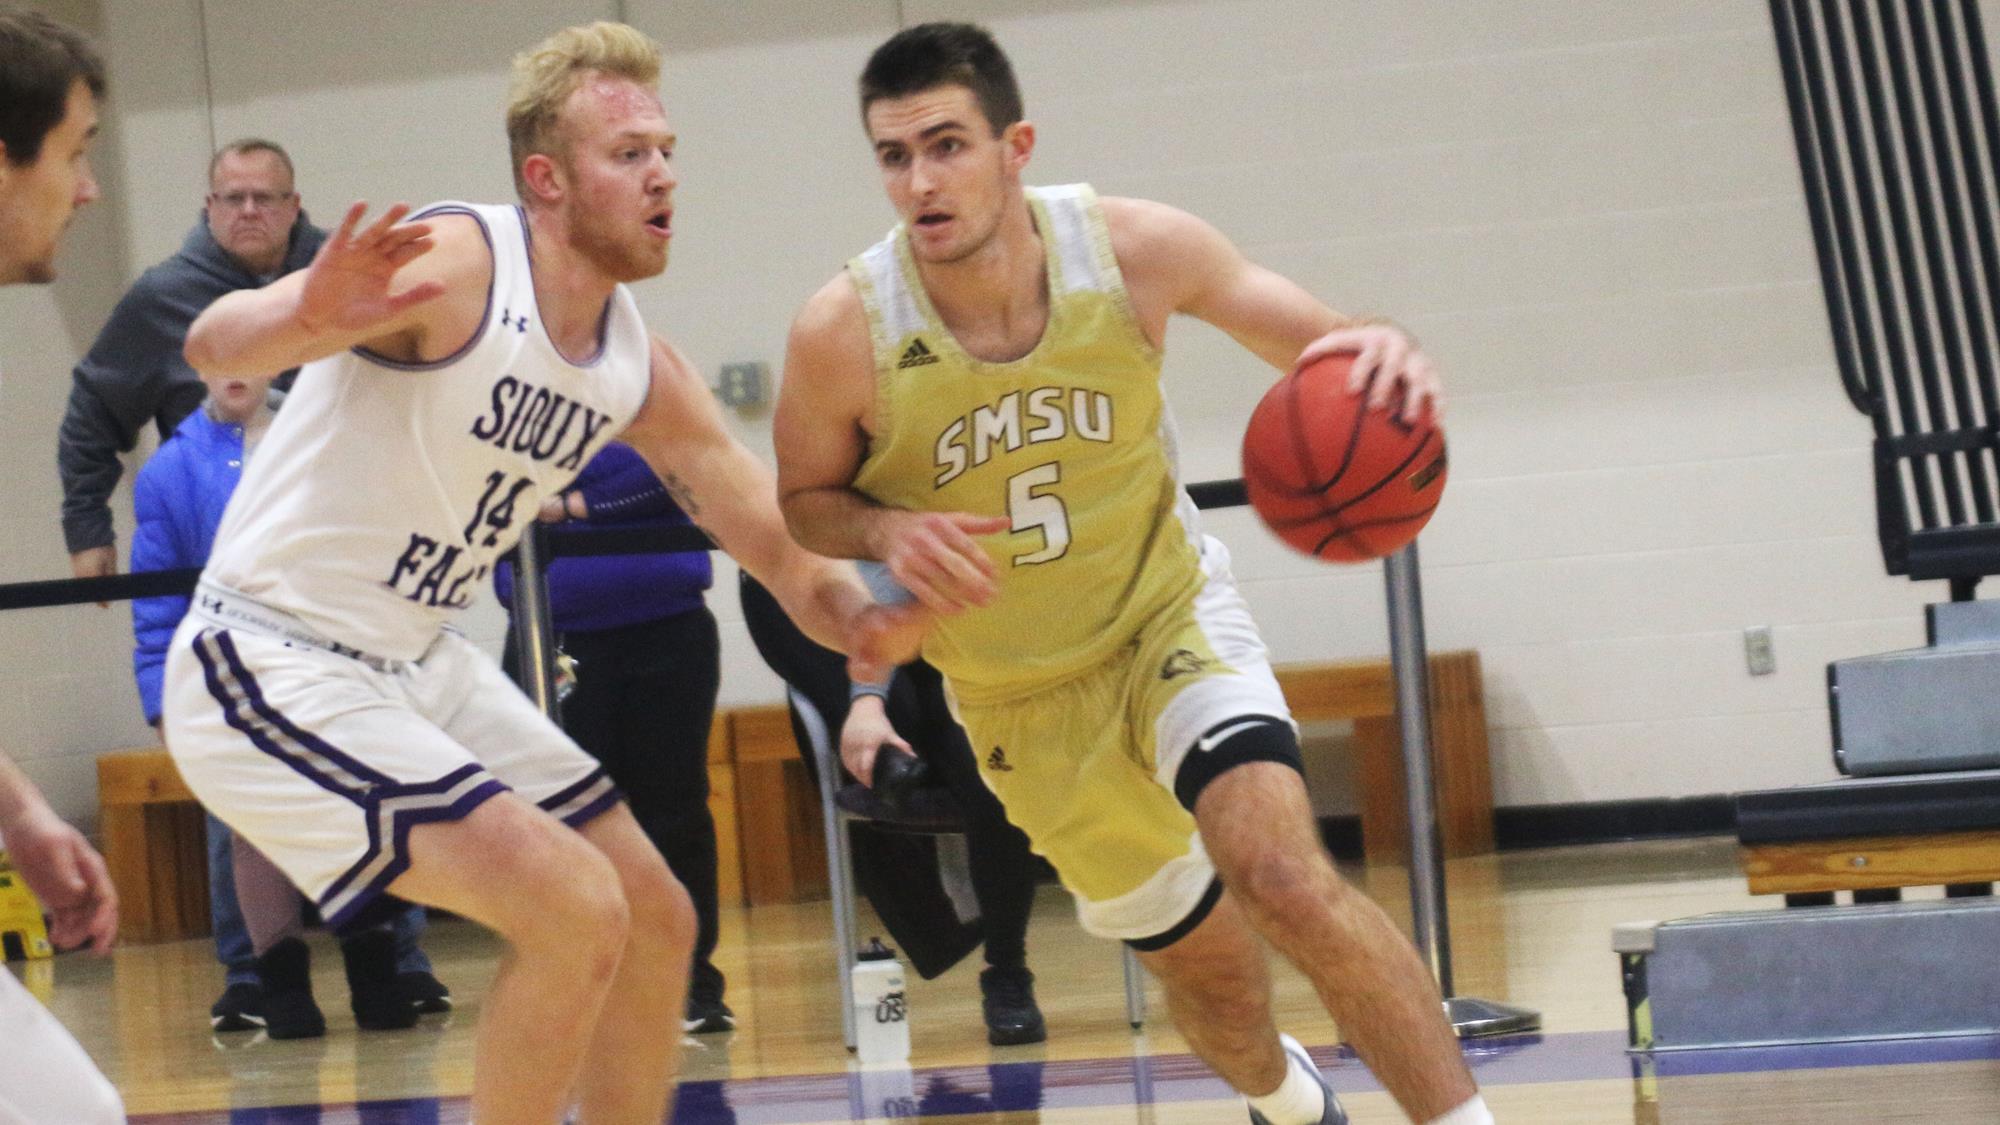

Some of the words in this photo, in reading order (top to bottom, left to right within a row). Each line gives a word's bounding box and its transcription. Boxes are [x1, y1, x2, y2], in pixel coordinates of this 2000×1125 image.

[470, 376, 612, 471] SIOUX
[933, 386, 1114, 490] SMSU
[464, 470, 535, 546] 14
[1006, 460, 1072, 567] 5
[387, 532, 487, 609] FAL
